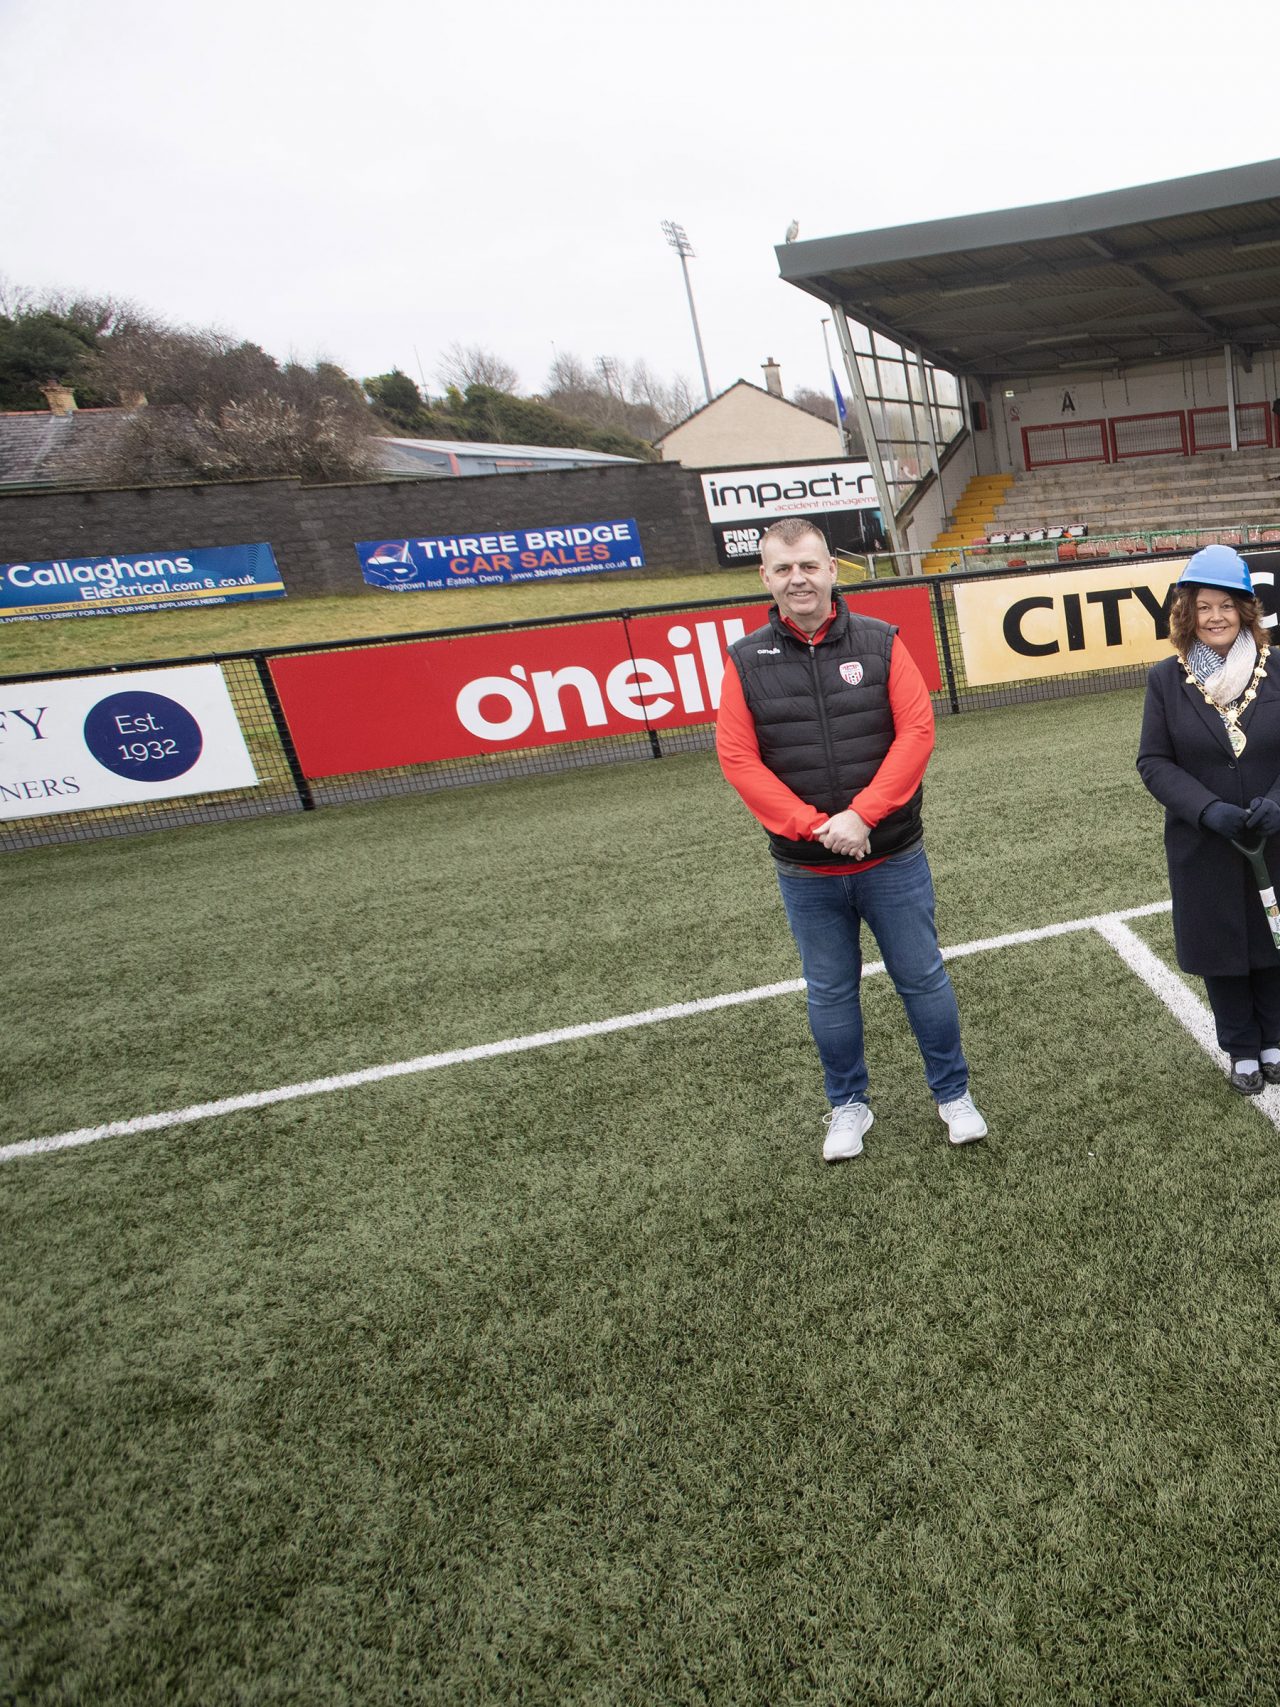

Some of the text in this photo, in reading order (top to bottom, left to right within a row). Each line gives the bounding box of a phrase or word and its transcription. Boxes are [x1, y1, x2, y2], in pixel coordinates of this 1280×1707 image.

[1062, 391, 1076, 411] A
[417, 523, 632, 559] THREE BRIDGE
[722, 528, 760, 543] FIND
[725, 539, 764, 554] GRE
[449, 544, 611, 575] CAR SALES
[7, 557, 193, 588] Callaghans
[479, 574, 503, 585] Derry
[80, 575, 256, 600] Electrical.com & .co.uk
[39, 613, 50, 621] TO
[51, 610, 78, 619] DERRY
[79, 609, 95, 617] FOR
[96, 607, 111, 616] ALL
[111, 605, 134, 614] YOUR
[134, 603, 157, 612] HOME
[158, 599, 200, 610] APPLIANCE
[1002, 585, 1177, 657] CITY
[456, 618, 746, 741] o'neil
[114, 712, 164, 735] Est.
[118, 738, 179, 762] 1932
